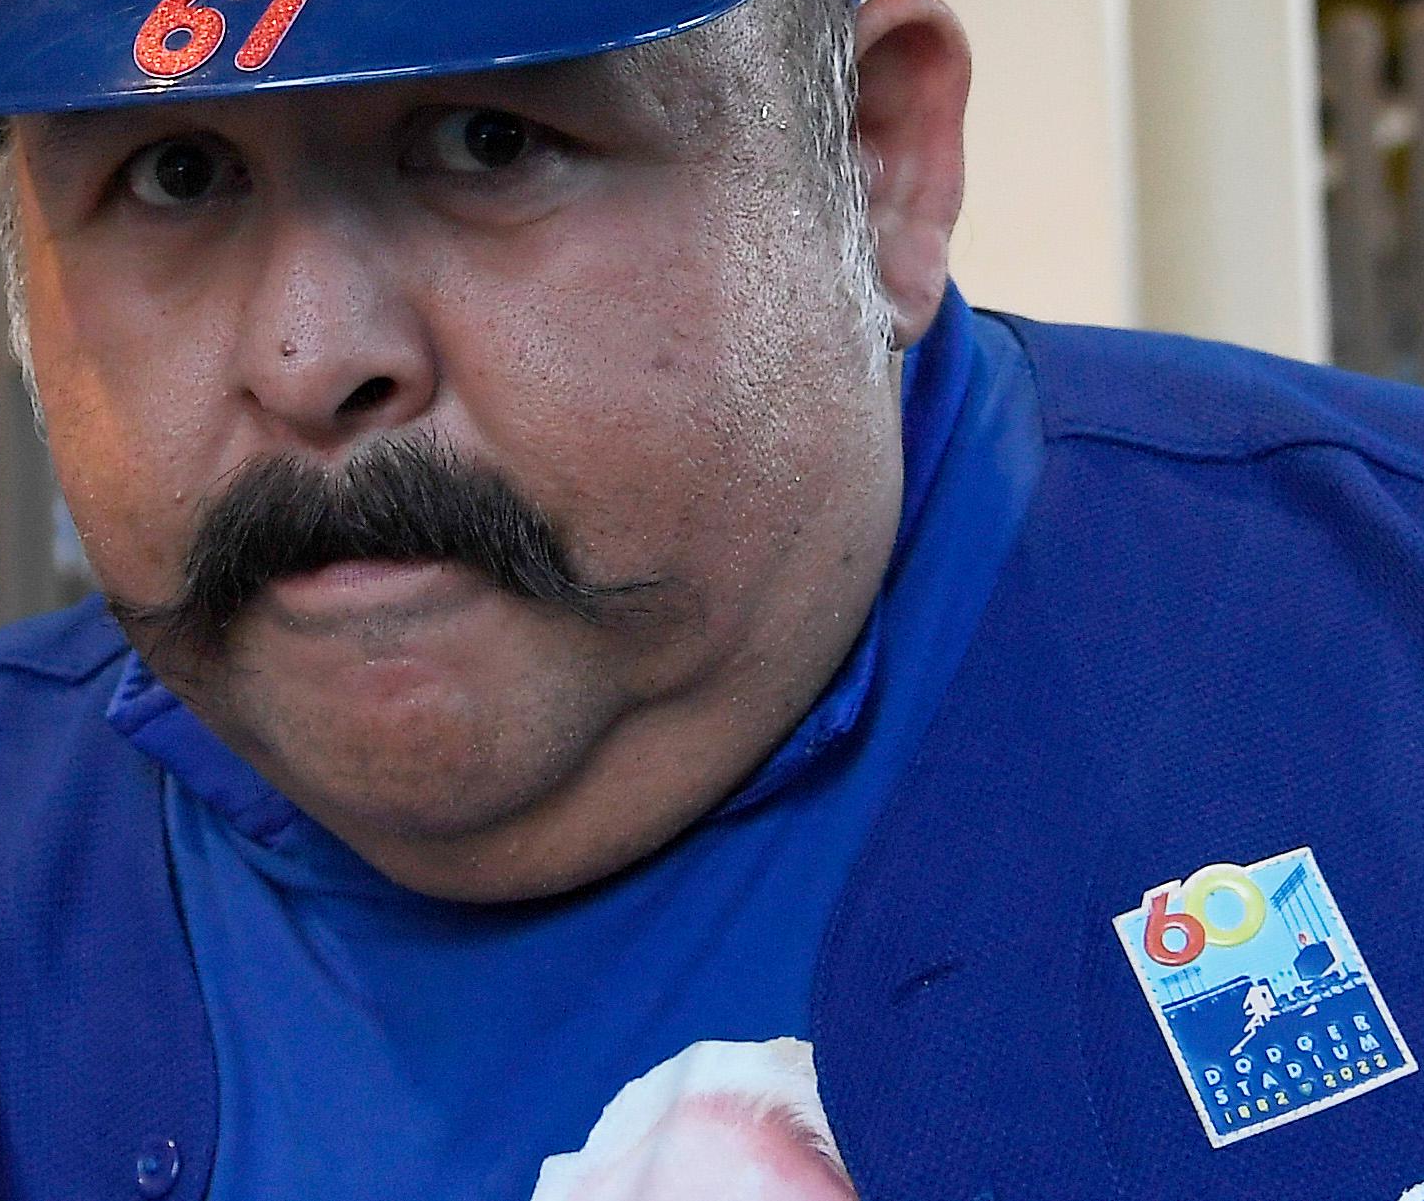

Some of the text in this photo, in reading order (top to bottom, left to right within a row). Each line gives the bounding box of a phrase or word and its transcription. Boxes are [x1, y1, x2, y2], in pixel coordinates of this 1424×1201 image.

[1143, 865, 1267, 967] 60
[1204, 1014, 1371, 1086] DODGER
[1214, 1033, 1381, 1105] STADIUM
[1322, 1052, 1388, 1089] 2022
